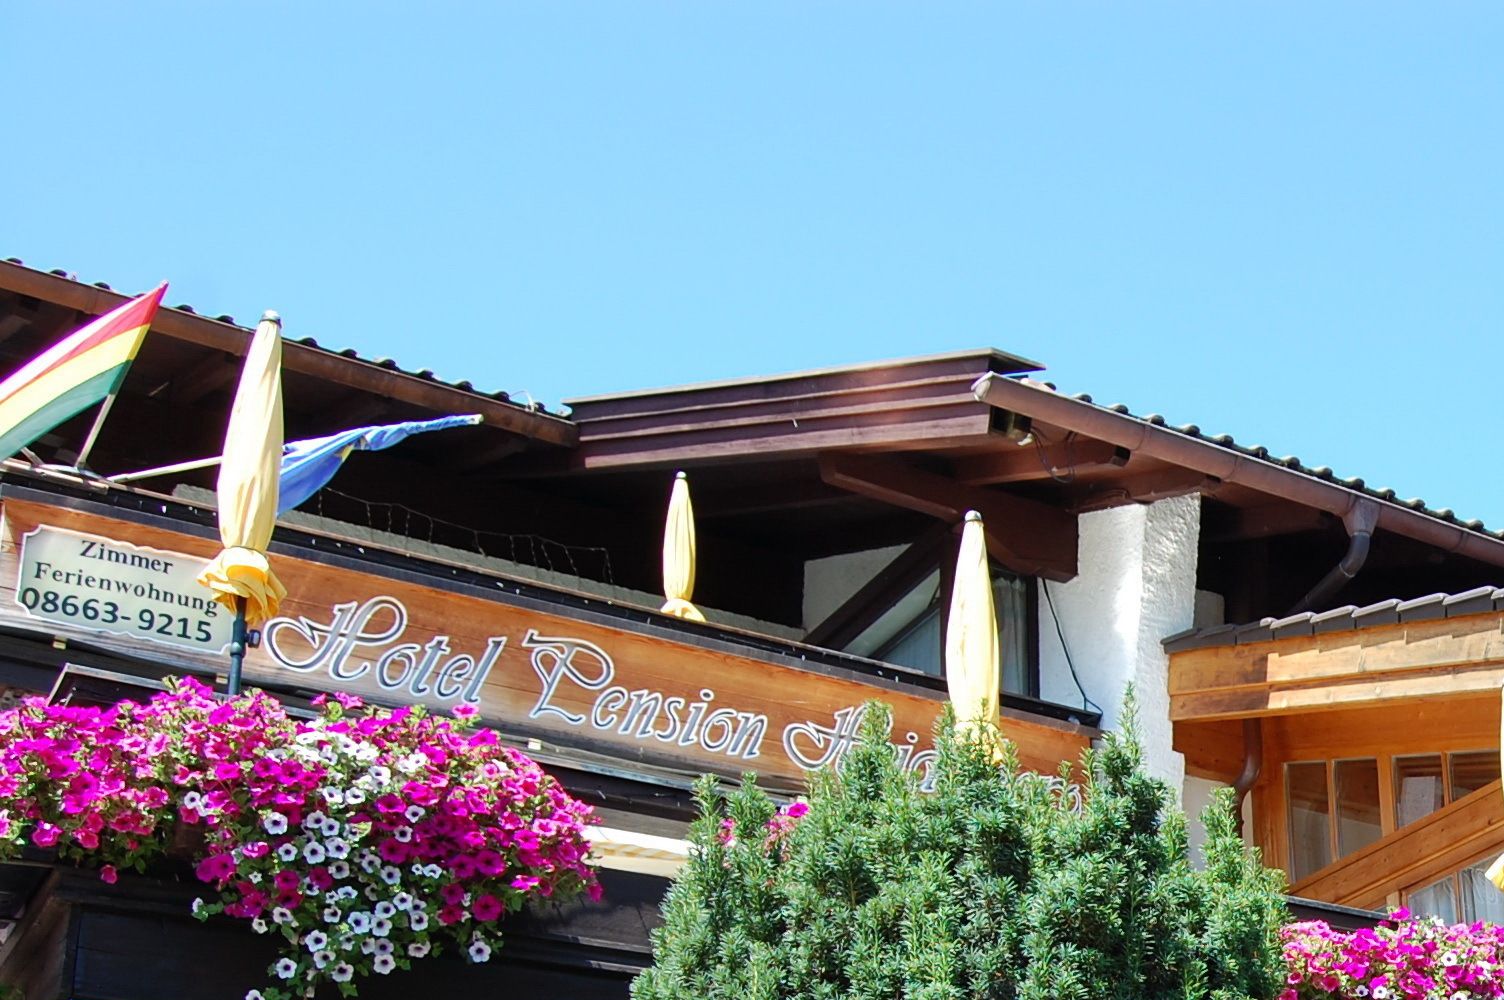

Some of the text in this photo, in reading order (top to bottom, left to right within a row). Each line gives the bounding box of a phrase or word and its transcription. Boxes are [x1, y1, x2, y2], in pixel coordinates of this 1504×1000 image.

[80, 539, 174, 575] Zimmer
[34, 561, 218, 618] Ferienwohnung
[264, 595, 768, 759] Hotel Pension
